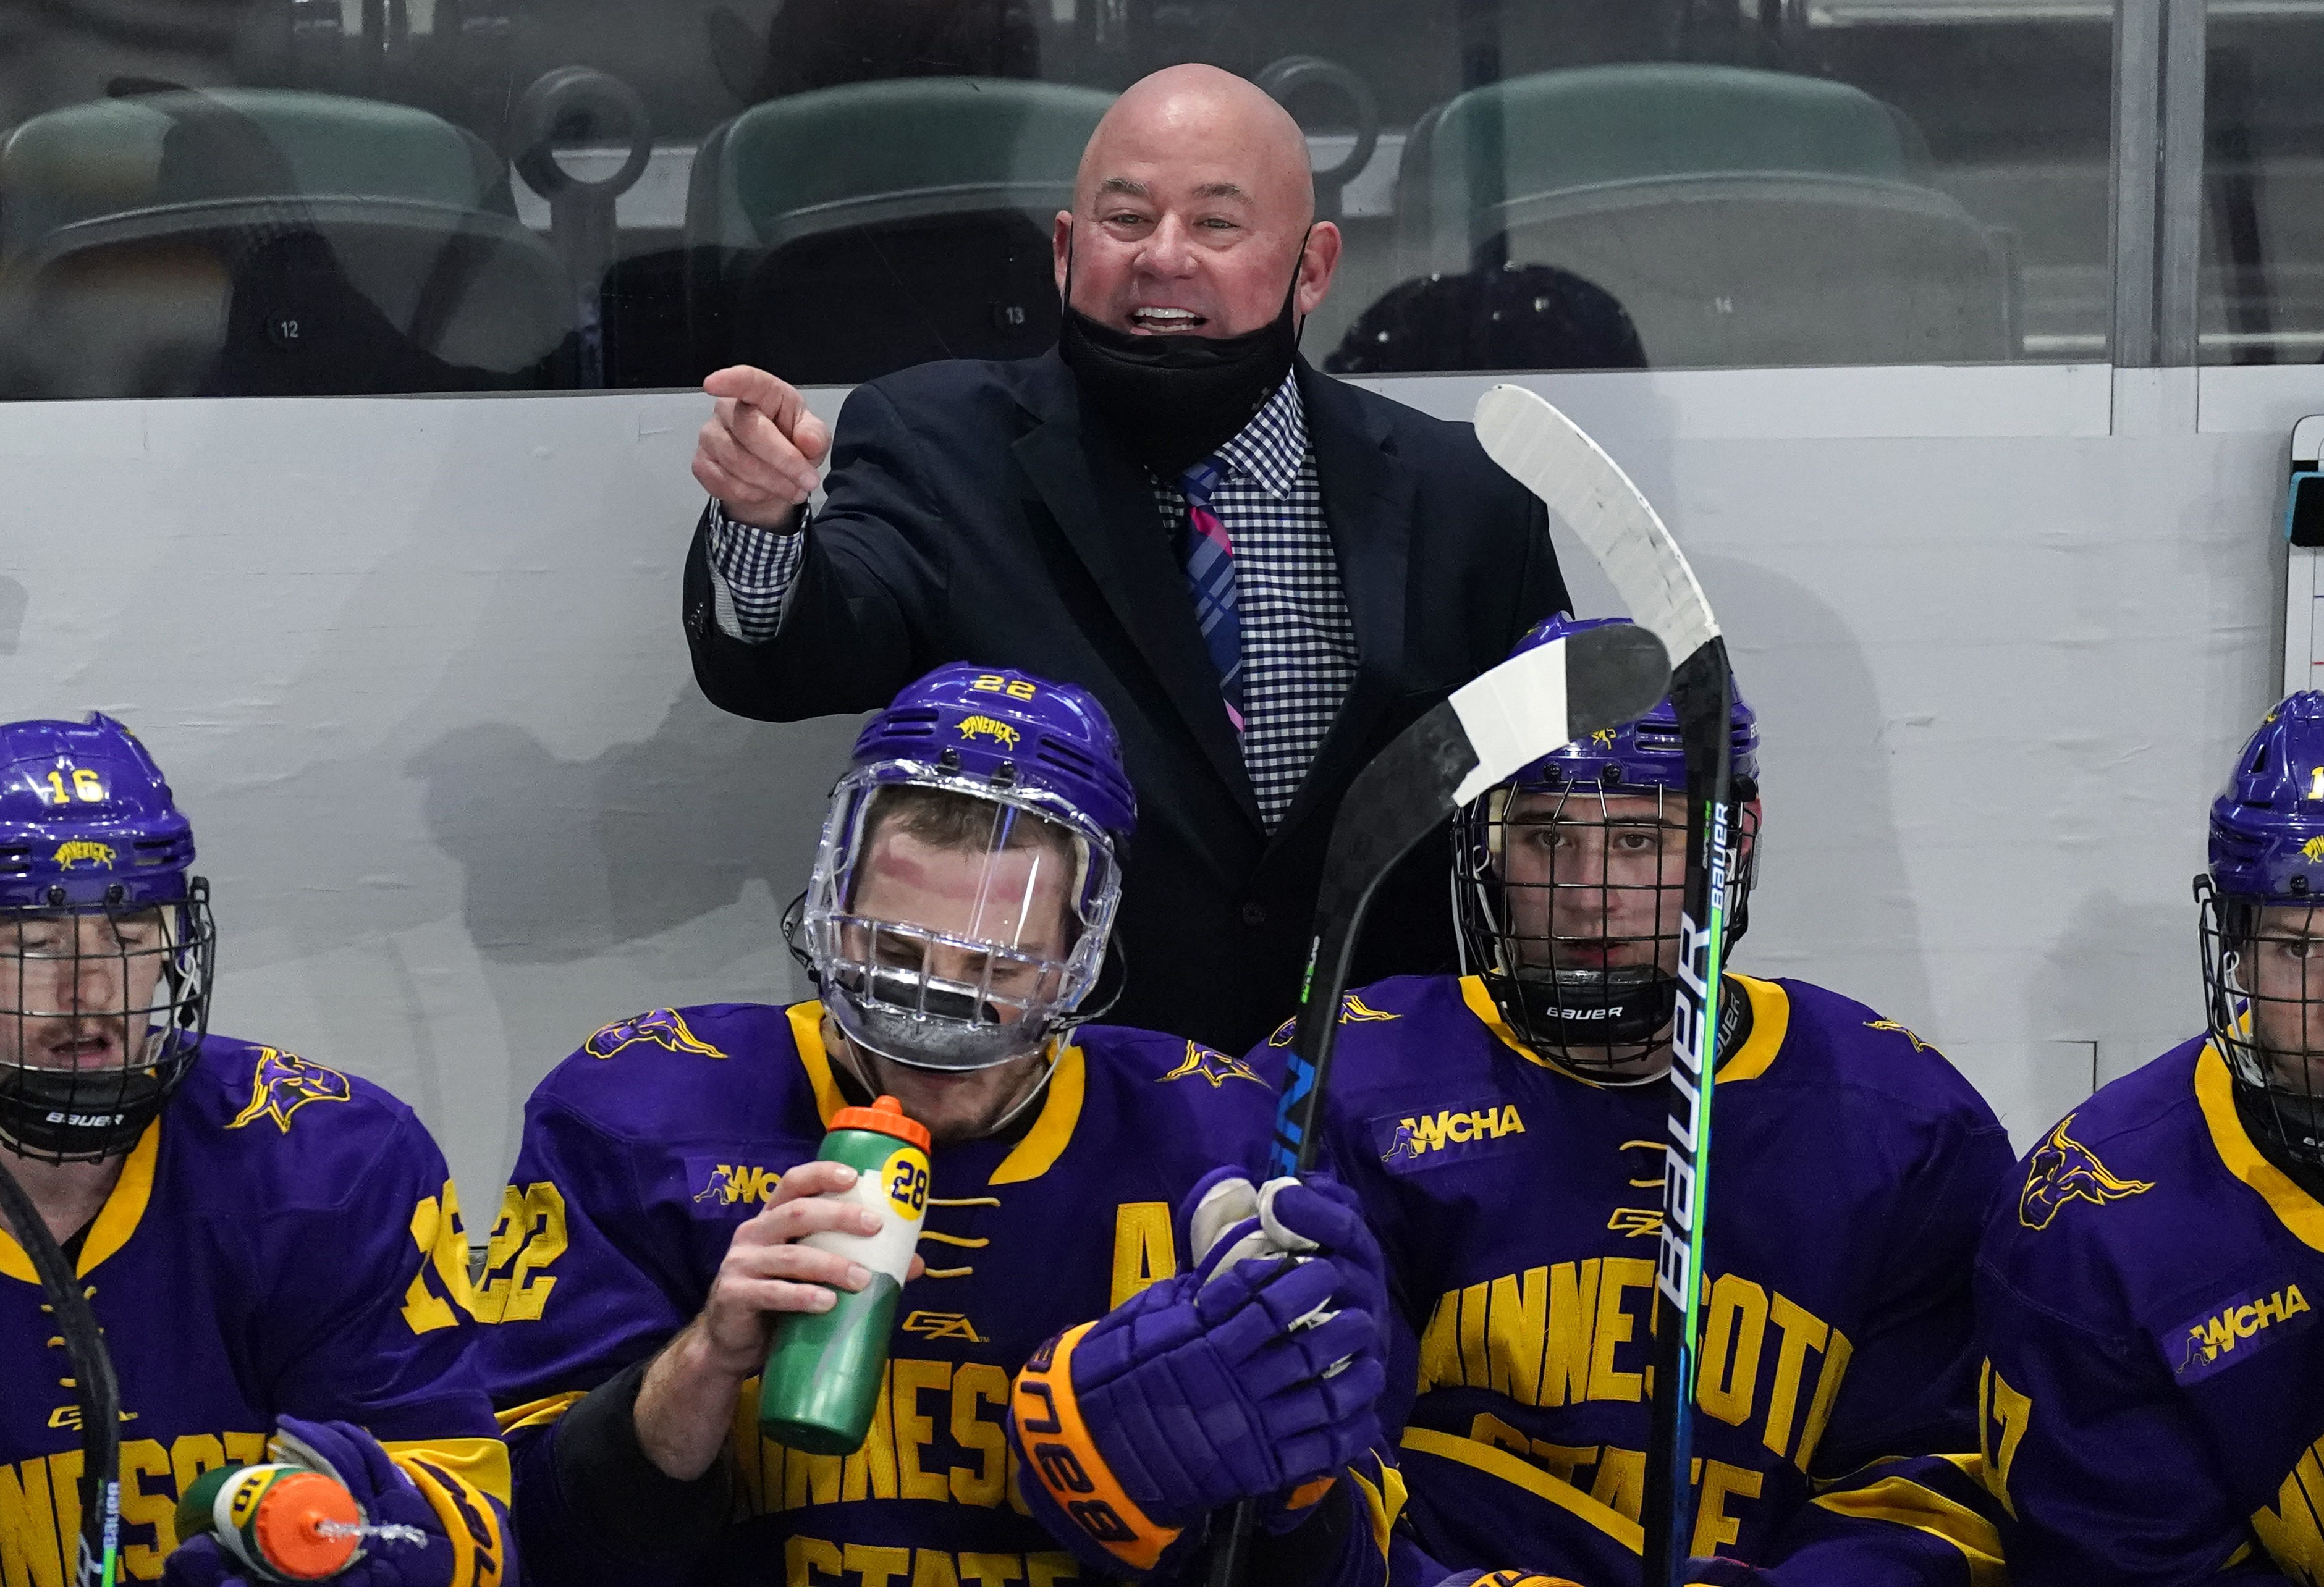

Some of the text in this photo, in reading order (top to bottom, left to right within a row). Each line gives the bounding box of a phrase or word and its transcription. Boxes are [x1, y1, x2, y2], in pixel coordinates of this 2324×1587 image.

[281, 320, 298, 339] 12
[1005, 306, 1025, 324] 13
[974, 674, 1036, 701] 22
[47, 768, 104, 804] 16
[1710, 802, 1728, 911] BAUER
[1546, 1006, 1623, 1020] BAUER
[1400, 1104, 1526, 1154] WCHA
[1658, 911, 1711, 1313] BAUER
[892, 1160, 927, 1211] 28
[1110, 1201, 1178, 1313] A
[2189, 1283, 2312, 1362] WCHA
[1020, 1328, 1141, 1542] BAUE
